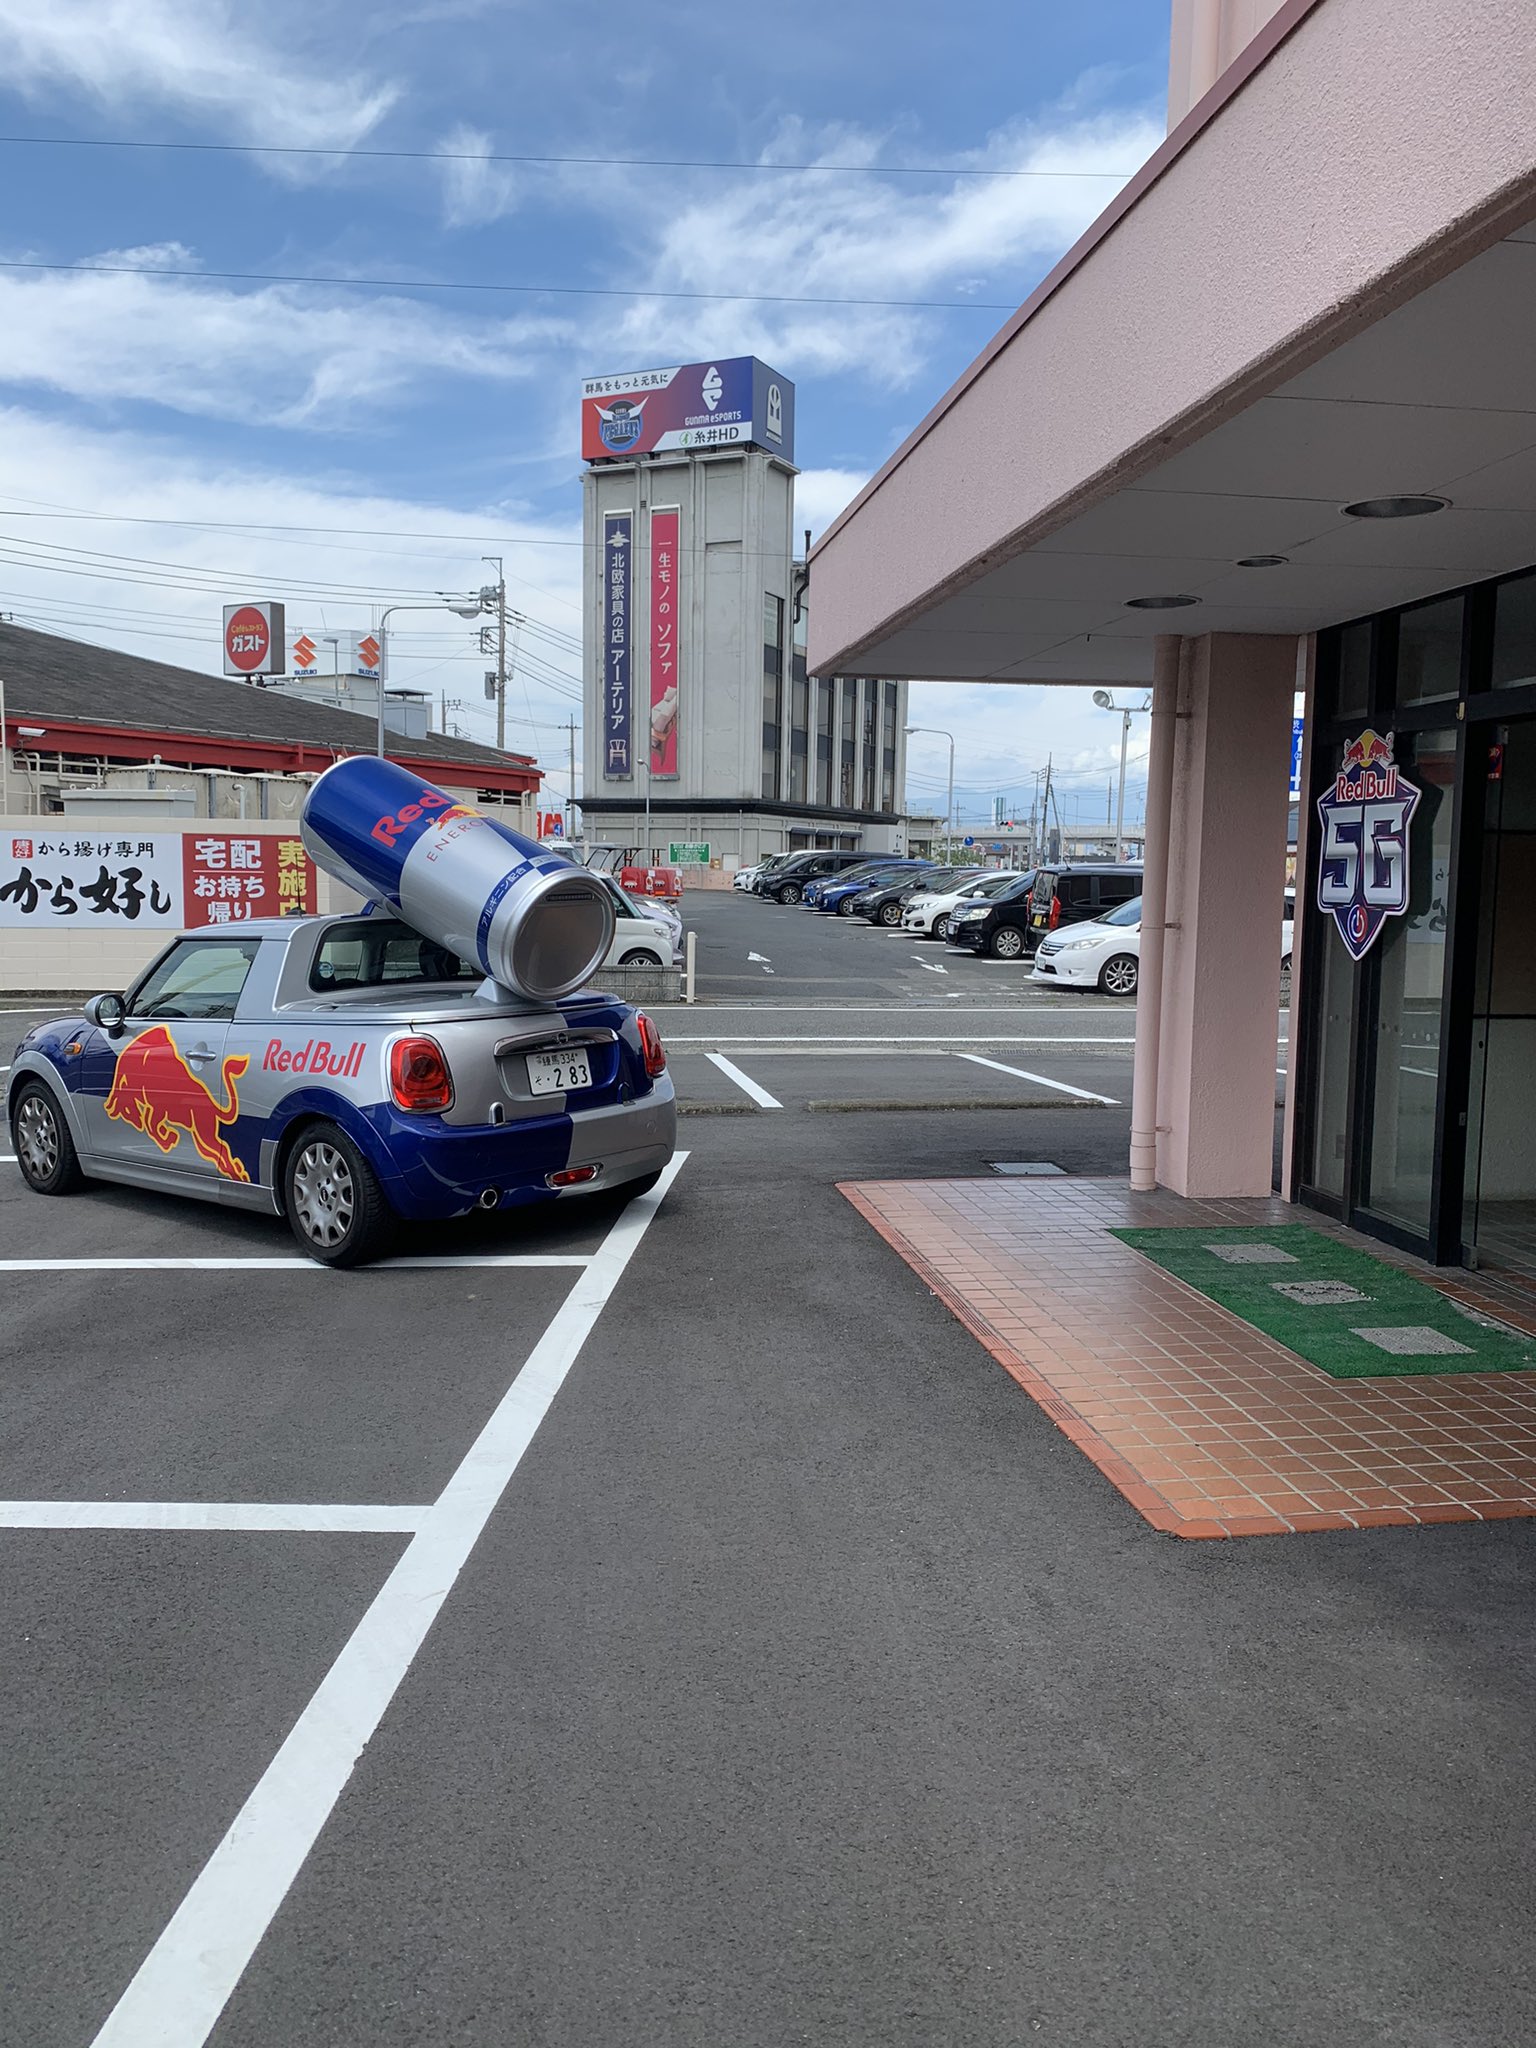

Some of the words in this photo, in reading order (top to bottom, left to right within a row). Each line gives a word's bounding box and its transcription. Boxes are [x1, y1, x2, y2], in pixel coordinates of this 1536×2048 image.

[585, 374, 668, 393] 群馬をもっと元気に
[711, 411, 741, 423] eSPORTS
[694, 427, 739, 444] 糸井HD
[611, 552, 625, 644] 北欧家具の店
[232, 635, 265, 652] ガスト
[294, 668, 317, 676] SUZUKI
[611, 650, 625, 730] アーテリア
[1336, 773, 1364, 801] Red
[1365, 768, 1397, 800] Bull
[371, 789, 451, 848] Red
[38, 841, 154, 858] から揚げ専門
[195, 838, 262, 869] 宅配
[0, 865, 171, 919] から好し
[193, 875, 265, 898] お持ち
[208, 901, 252, 923] 帰り
[262, 1038, 314, 1073] Red
[309, 1041, 366, 1078] Bull
